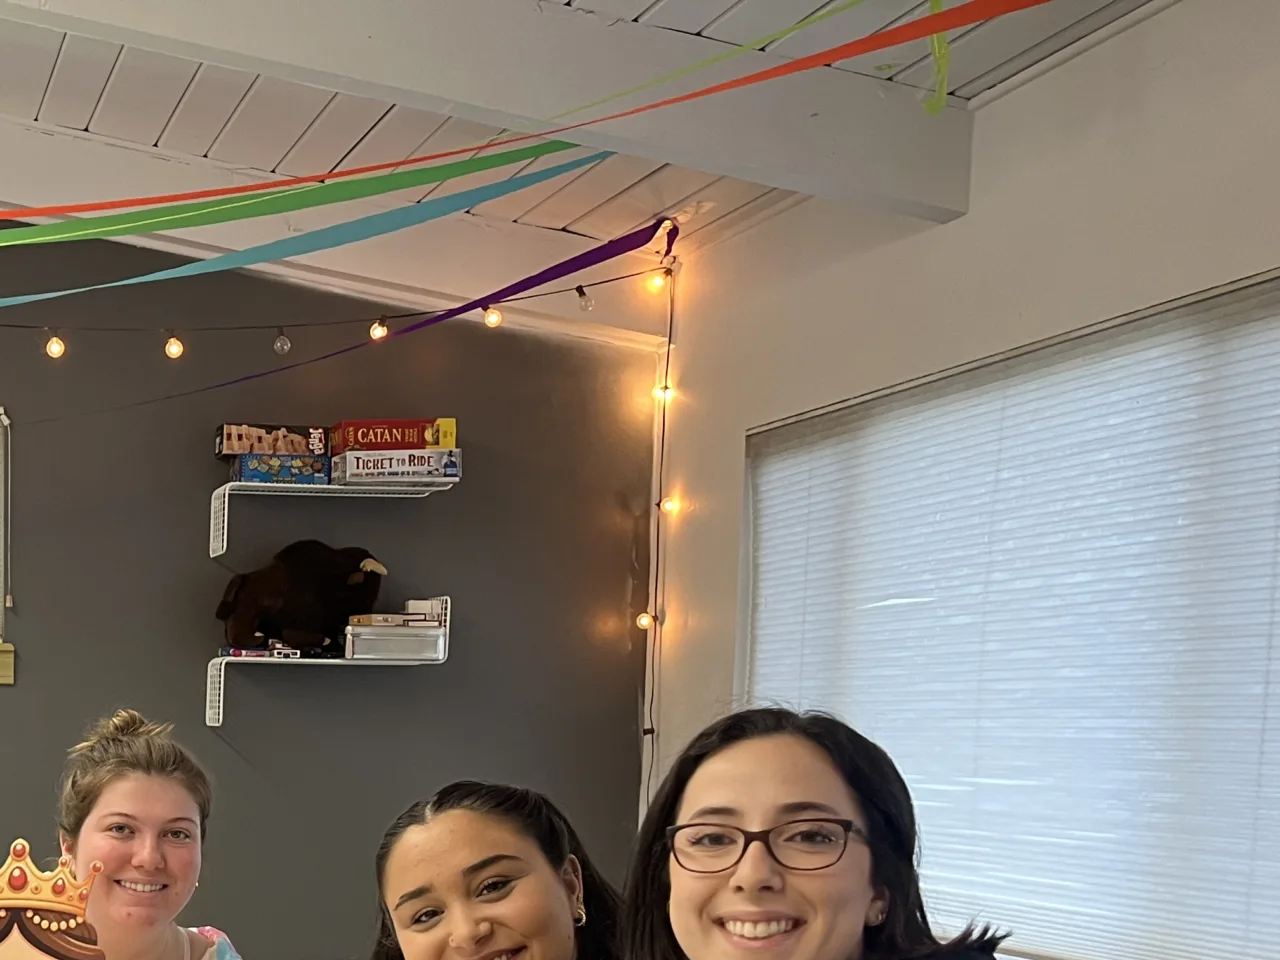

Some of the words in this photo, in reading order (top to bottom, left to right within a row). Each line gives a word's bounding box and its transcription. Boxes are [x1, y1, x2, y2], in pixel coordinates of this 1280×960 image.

[357, 428, 402, 443] CATAN
[354, 456, 394, 470] TICKET
[408, 454, 435, 467] RIDE
